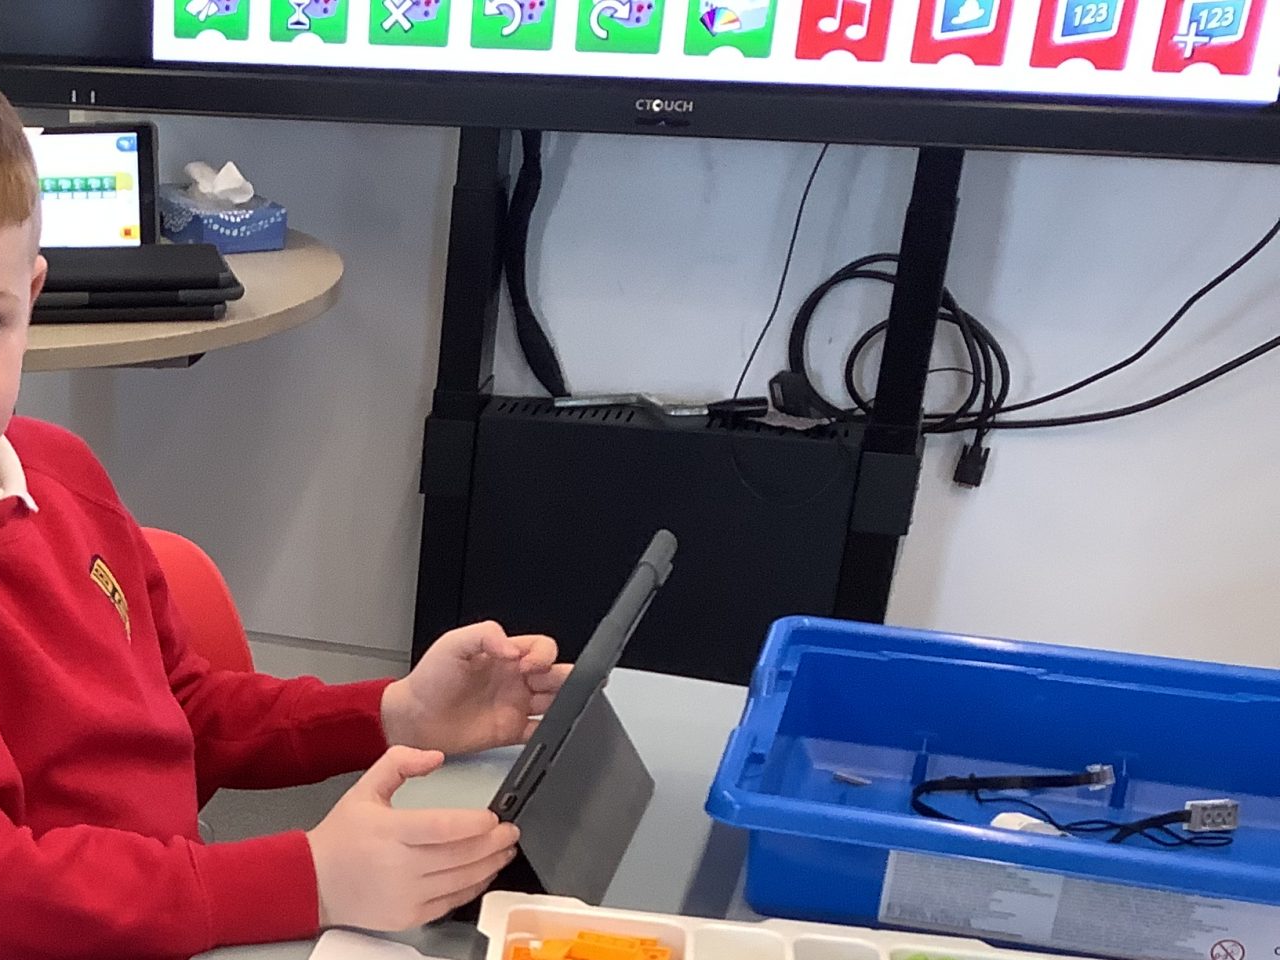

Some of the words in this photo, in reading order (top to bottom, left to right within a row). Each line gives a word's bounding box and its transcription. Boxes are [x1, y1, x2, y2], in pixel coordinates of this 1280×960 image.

[1073, 3, 1108, 28] 123
[1198, 6, 1234, 31] 123
[635, 98, 694, 112] CTOUCH
